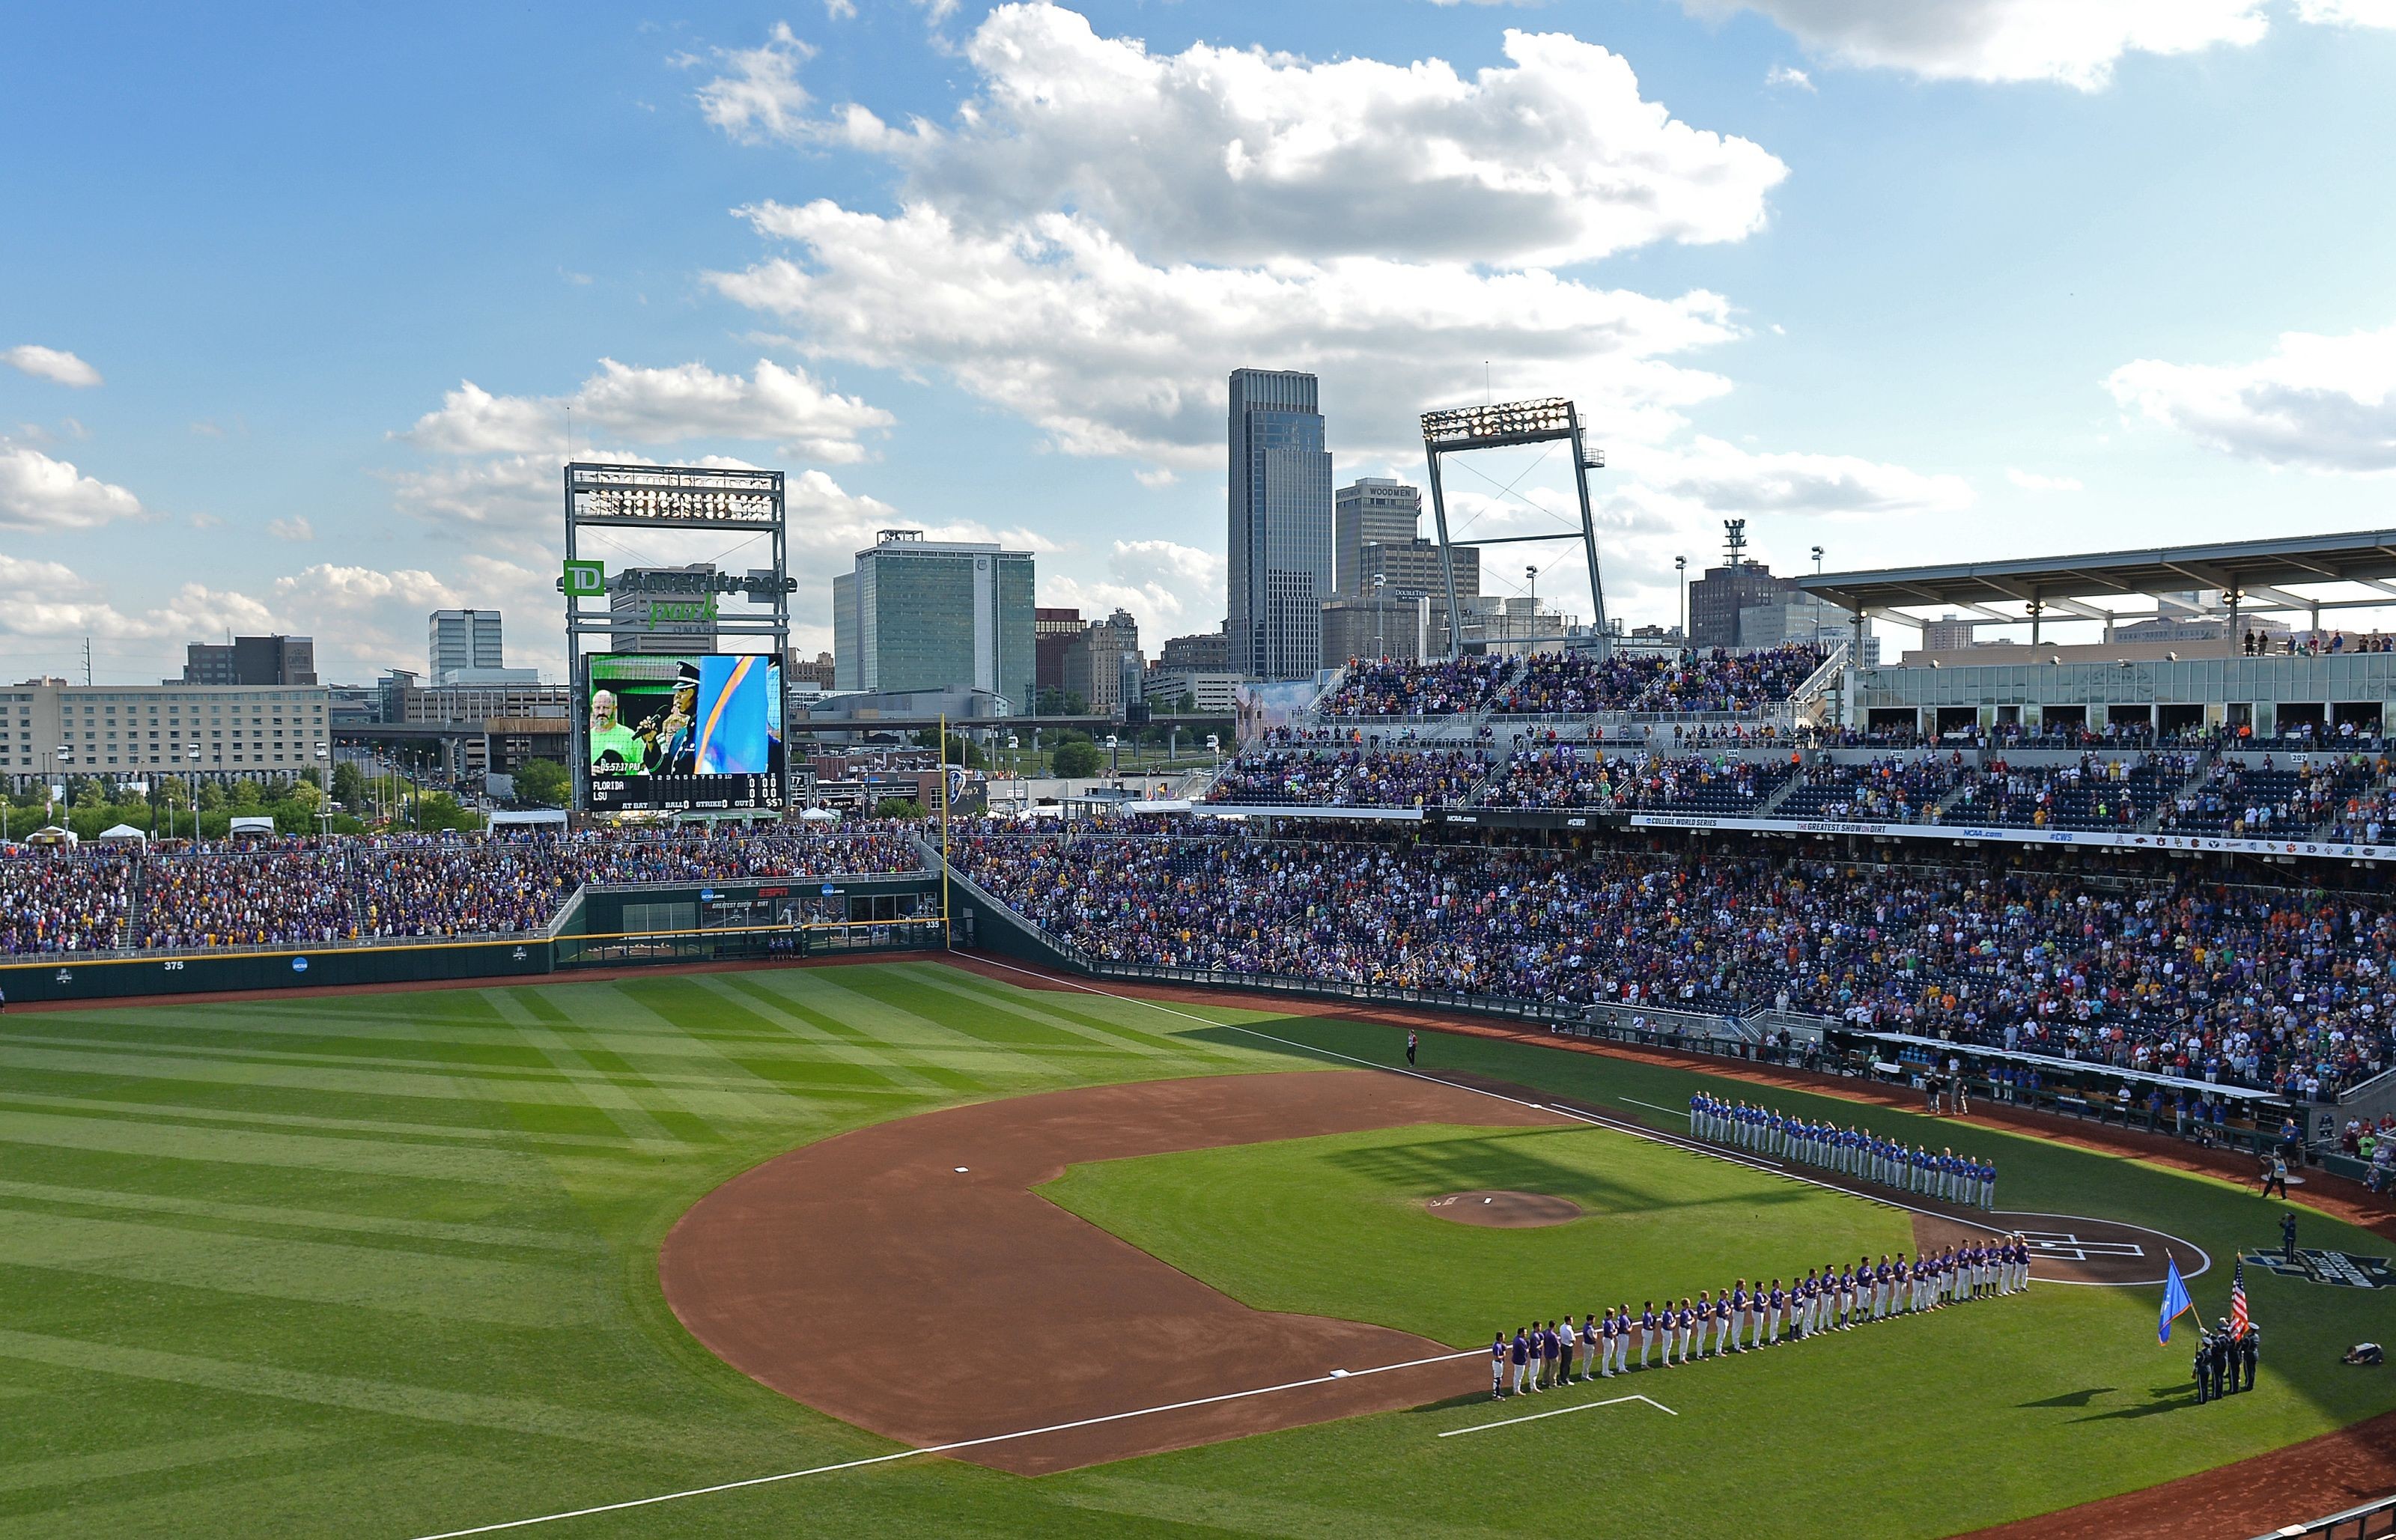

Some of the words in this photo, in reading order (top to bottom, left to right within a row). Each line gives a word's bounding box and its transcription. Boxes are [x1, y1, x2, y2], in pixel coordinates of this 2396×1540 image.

[1369, 487, 1411, 496] WOODMEN
[568, 567, 600, 590] TD
[618, 569, 797, 593] Ameritrade
[648, 591, 719, 630] park
[674, 626, 719, 634] OMAHA
[593, 781, 624, 791] FLORIDA
[749, 778, 755, 788] 0
[762, 778, 768, 788] 0
[770, 778, 776, 788] 0
[593, 791, 607, 801] LSU
[749, 788, 755, 798] 0
[762, 788, 768, 798] 0
[770, 788, 776, 798] 0
[684, 800, 690, 809] 0
[749, 799, 755, 808] 0
[1567, 818, 1586, 827] #CWS
[1807, 823, 1840, 832] GREATEST
[1841, 824, 1861, 833] SHOW
[1870, 825, 1887, 833] DIRT
[1963, 830, 2002, 838] NCAA.com
[2049, 833, 2073, 841] #CWS
[758, 887, 789, 897] ESPN
[164, 961, 184, 970] 375
